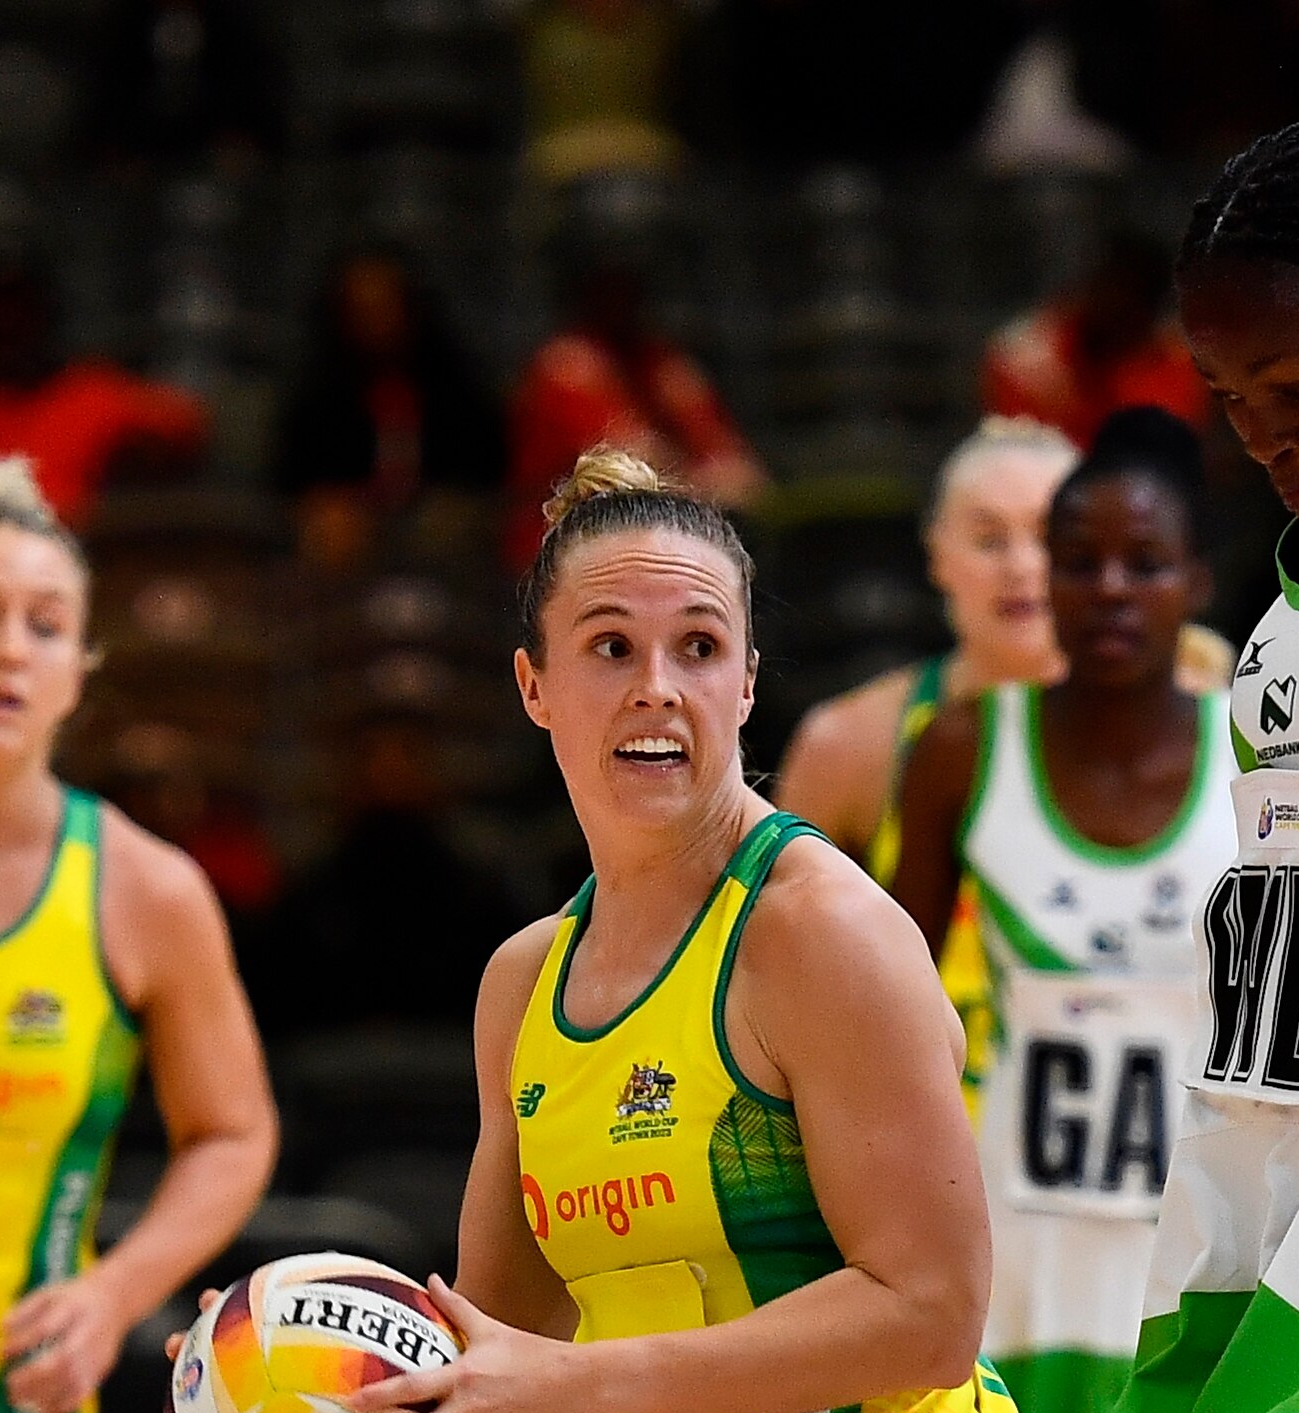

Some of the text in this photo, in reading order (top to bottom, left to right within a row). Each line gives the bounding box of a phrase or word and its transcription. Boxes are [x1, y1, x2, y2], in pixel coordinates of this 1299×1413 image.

[1024, 1040, 1167, 1192] GA
[556, 1172, 676, 1237] origin
[279, 1296, 453, 1367] LBERT
